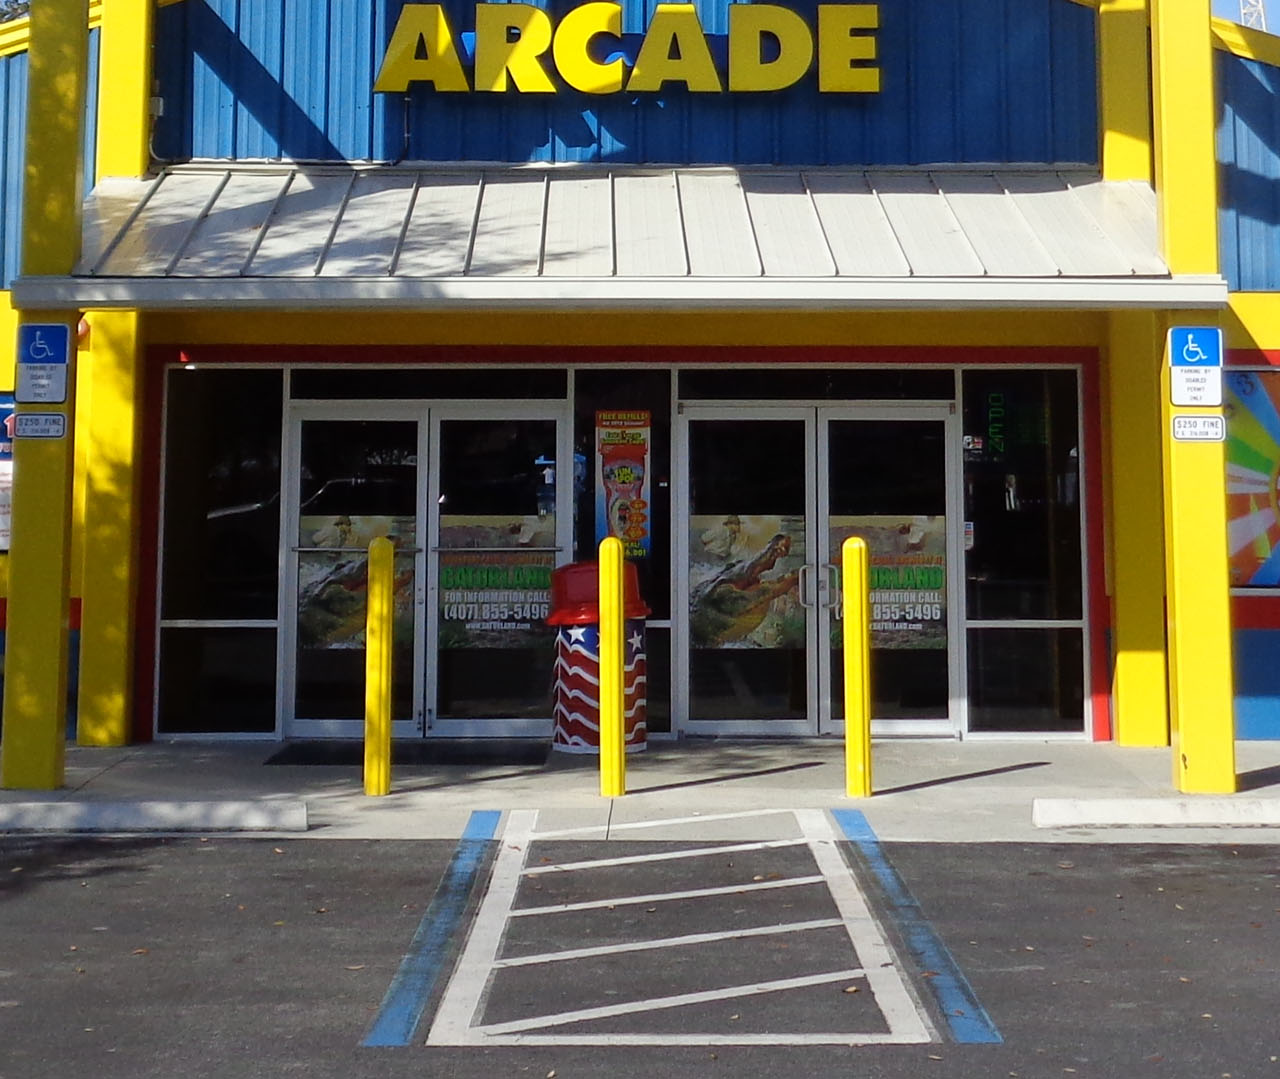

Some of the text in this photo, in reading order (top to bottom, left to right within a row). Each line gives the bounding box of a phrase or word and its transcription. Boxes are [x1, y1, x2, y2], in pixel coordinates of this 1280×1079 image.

[373, 1, 881, 94] ARCADE
[1176, 420, 1220, 429] $250 FINE
[444, 591, 462, 602] FOR
[464, 591, 525, 602] INFORMATION
[443, 603, 550, 620] (407) 855-5496
[873, 604, 941, 620] 855-5496
